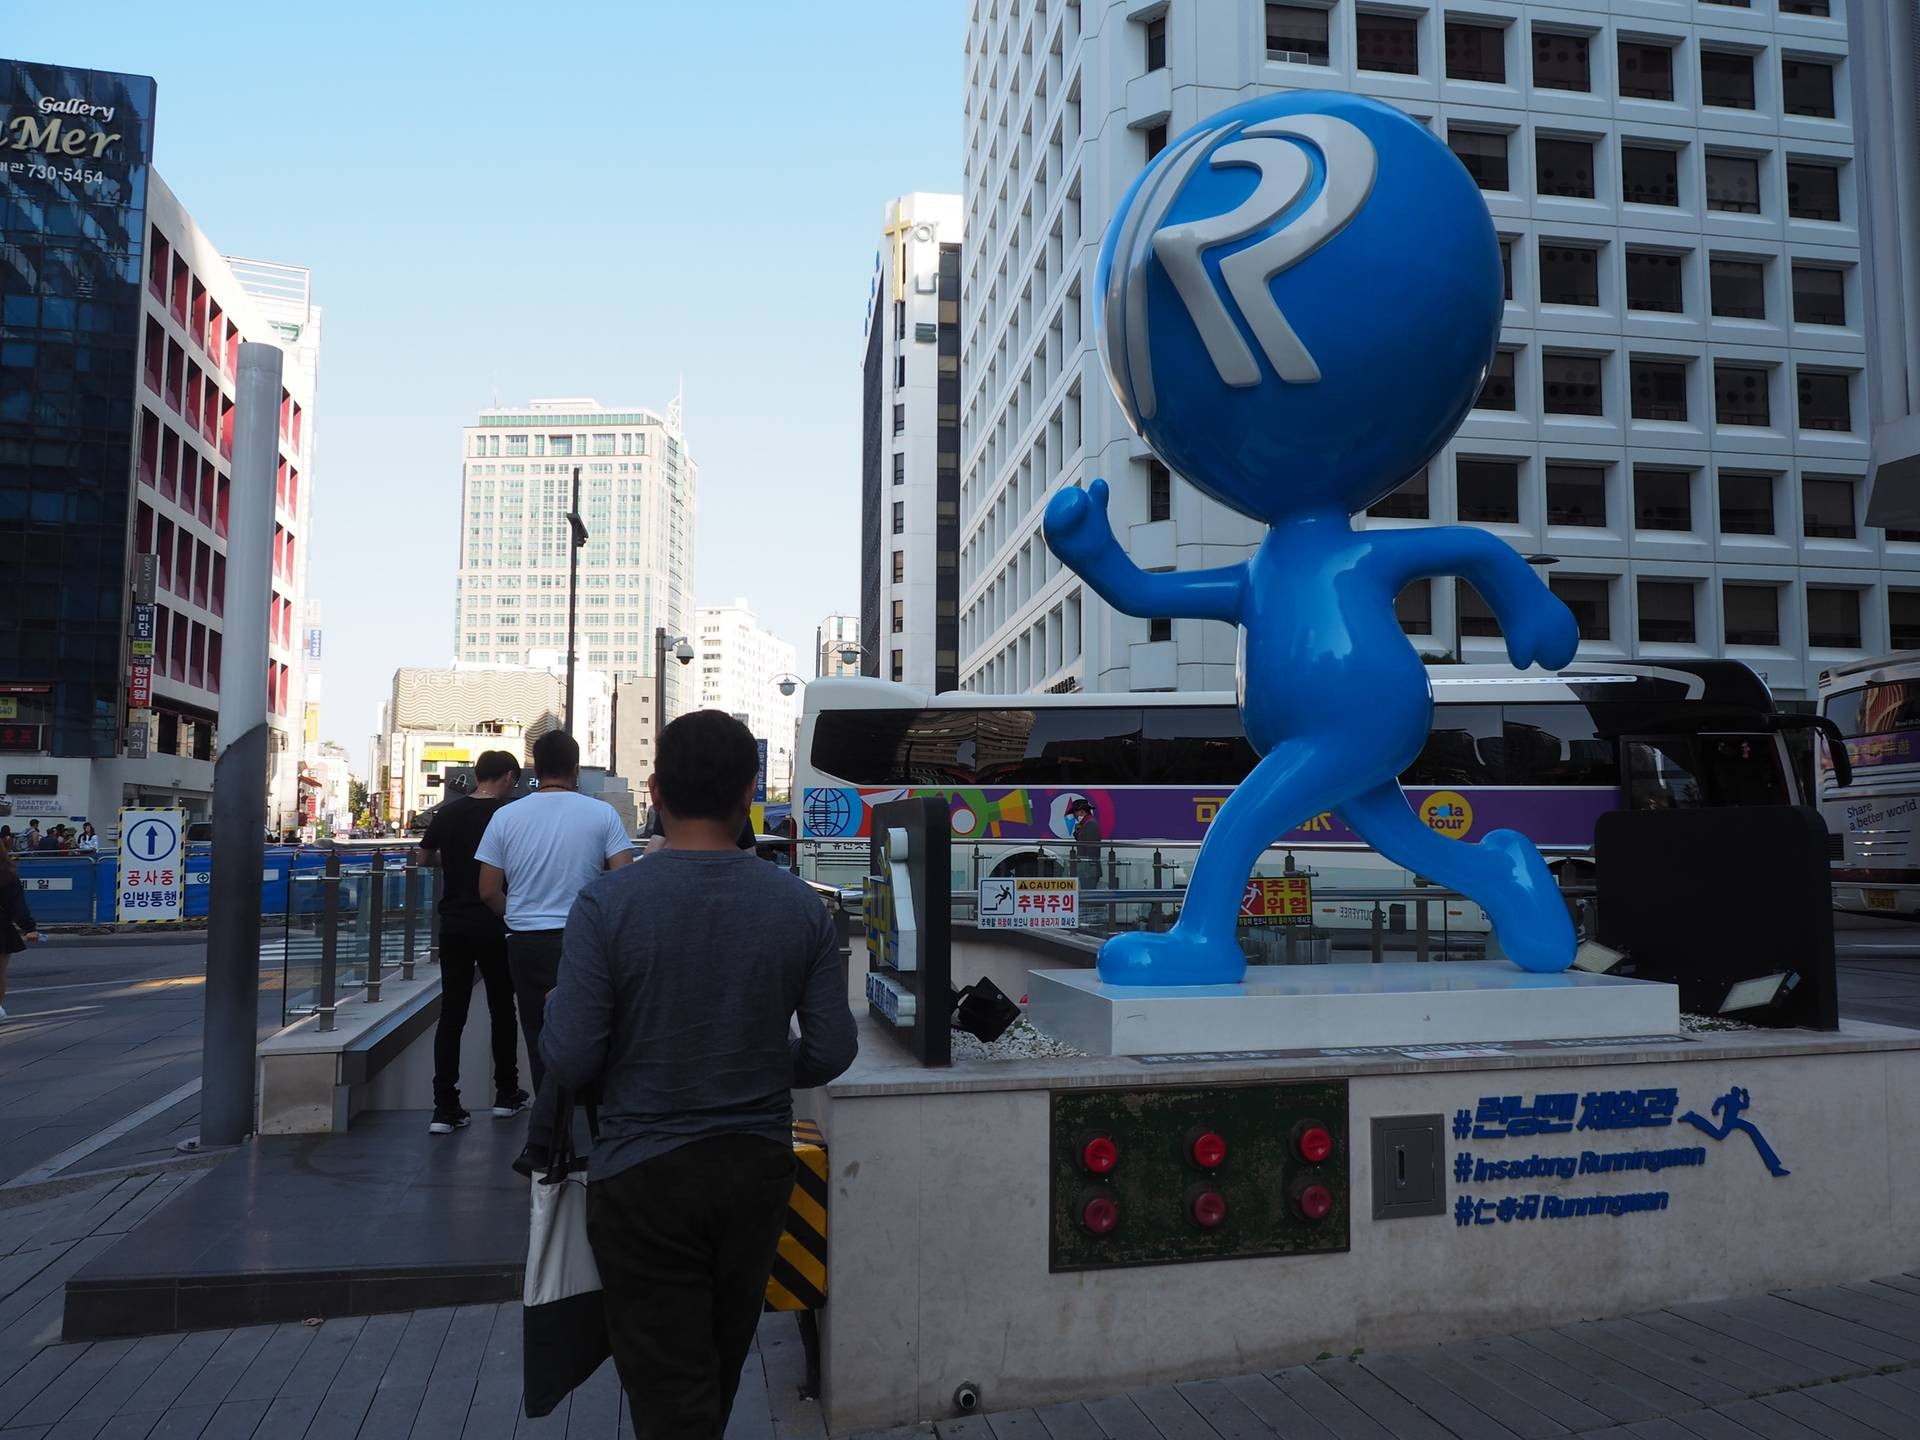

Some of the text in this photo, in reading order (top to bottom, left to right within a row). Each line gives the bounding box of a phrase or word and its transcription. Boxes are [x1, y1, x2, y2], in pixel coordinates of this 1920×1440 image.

[38, 96, 115, 122] Gallery
[27, 164, 104, 185] 730-5454
[138, 614, 150, 637] 미담
[133, 666, 149, 700] 한의원
[1847, 803, 1872, 818] Share
[1856, 811, 1884, 828] better
[1886, 799, 1917, 817] world
[1429, 817, 1464, 829] tour
[1029, 881, 1073, 890] CAUTION
[1266, 879, 1308, 897] 추락
[123, 891, 177, 908] 일방통행
[1018, 894, 1074, 913] 추락주의
[1267, 897, 1308, 914] 위험
[1577, 1088, 1679, 1131] 체험관
[1454, 1147, 1706, 1182] #Insadong Runningman
[1541, 1191, 1669, 1218] Runningman
